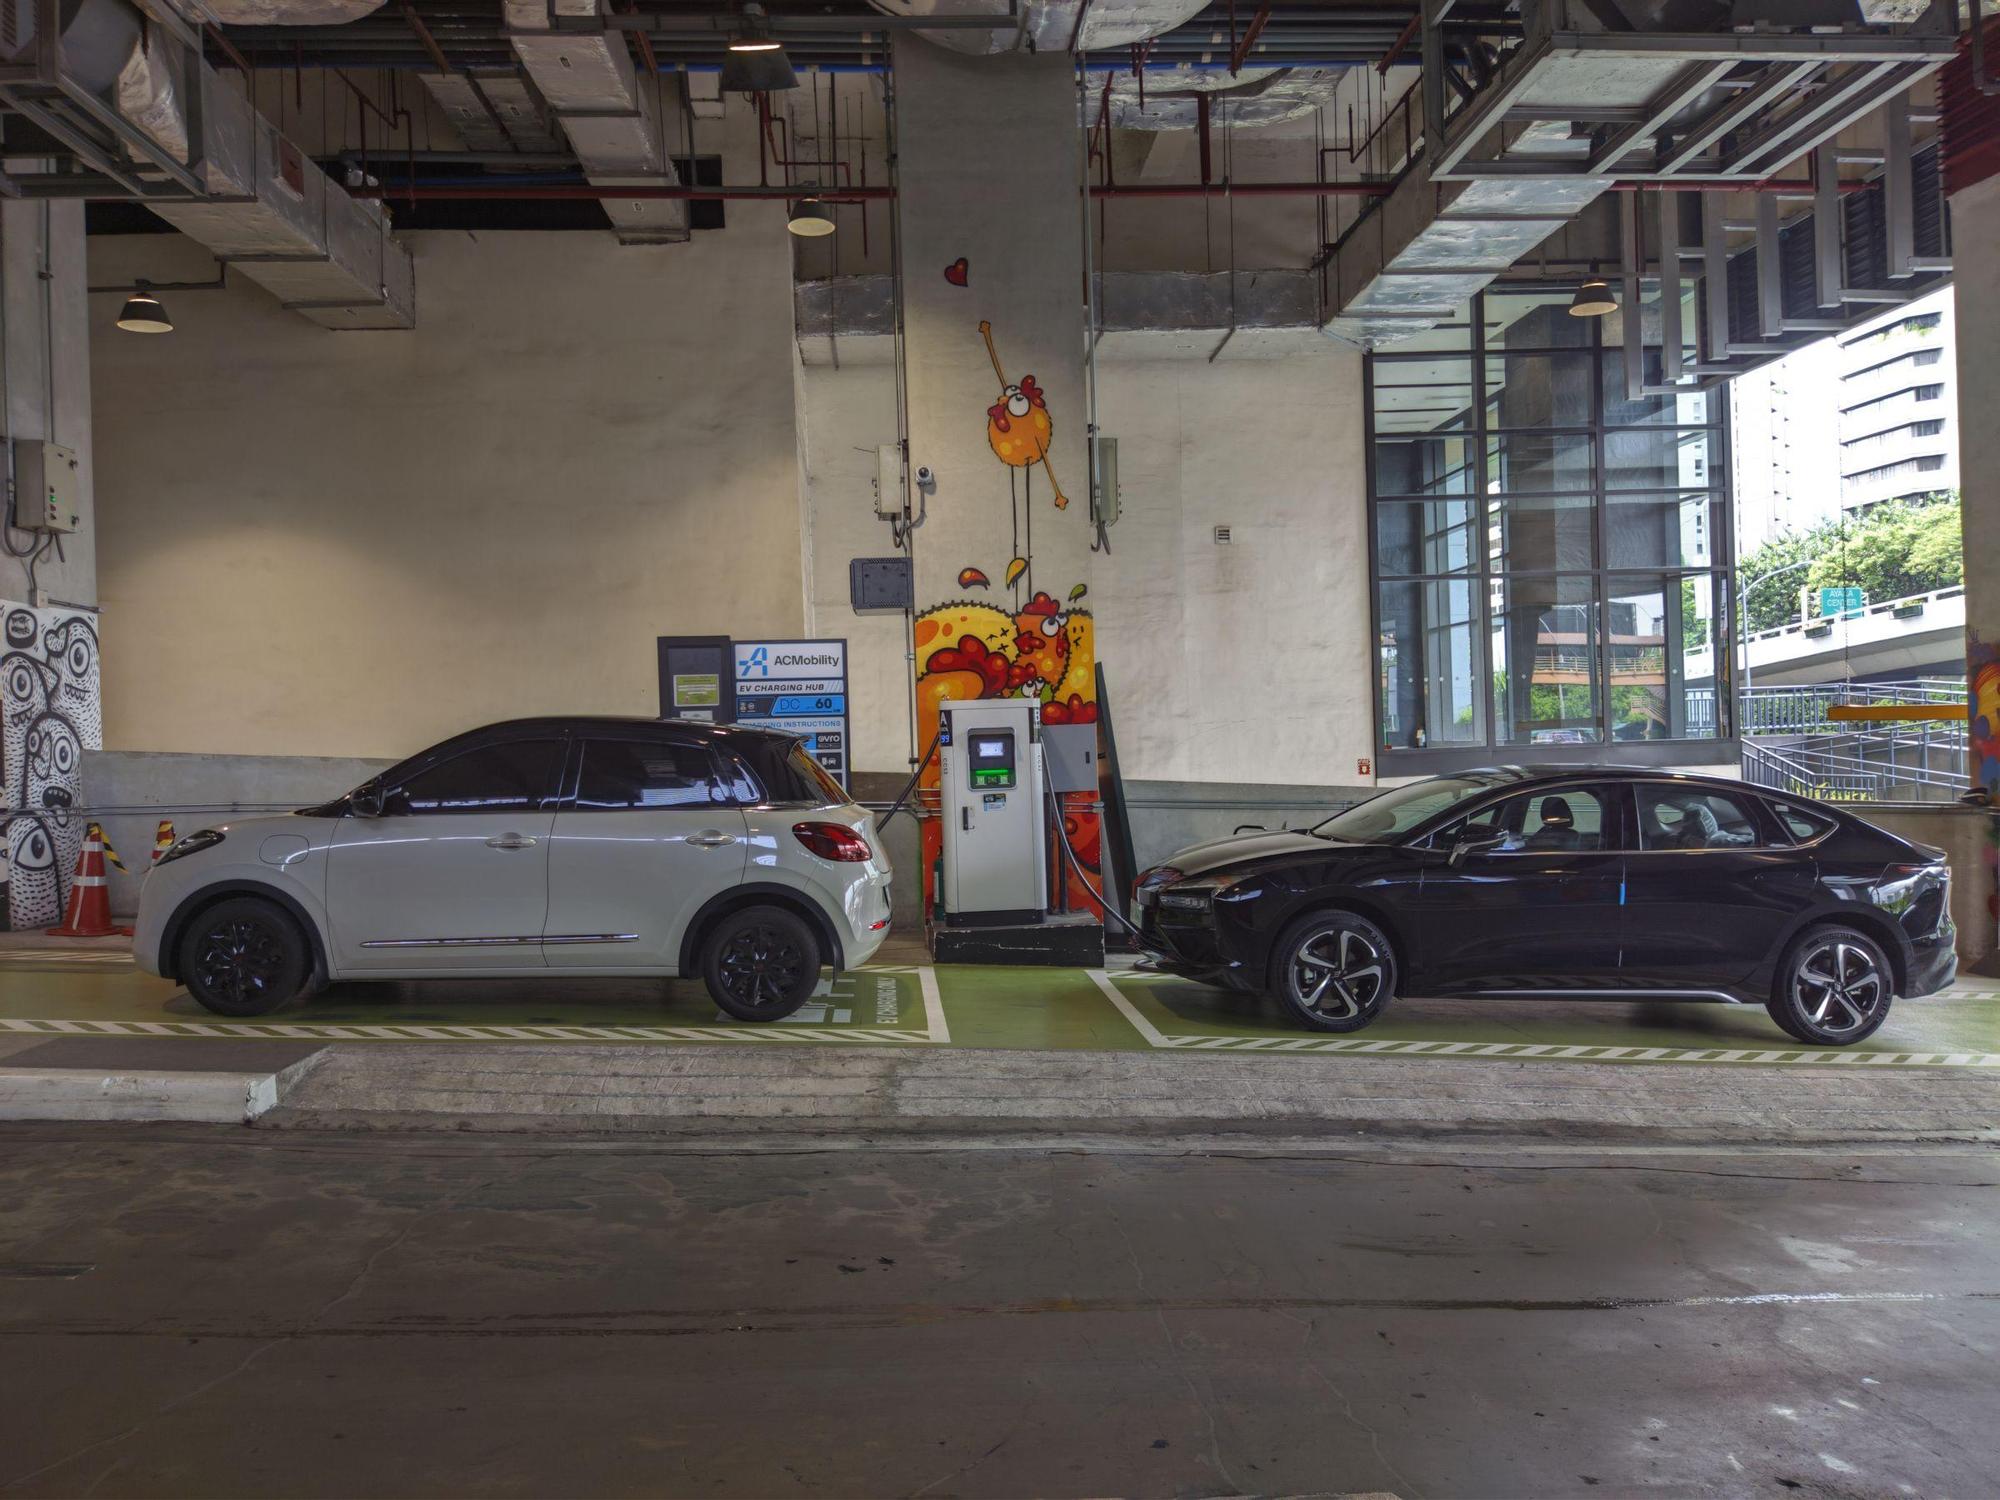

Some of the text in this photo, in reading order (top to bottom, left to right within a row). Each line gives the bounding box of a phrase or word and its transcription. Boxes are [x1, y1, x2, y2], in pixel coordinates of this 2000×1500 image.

[1828, 590, 1854, 598] AYAA
[774, 655, 839, 667] ACMobility
[754, 684, 803, 692] CHARGING
[780, 698, 833, 710] DC 60
[783, 720, 841, 728] INSTRUCTIONS
